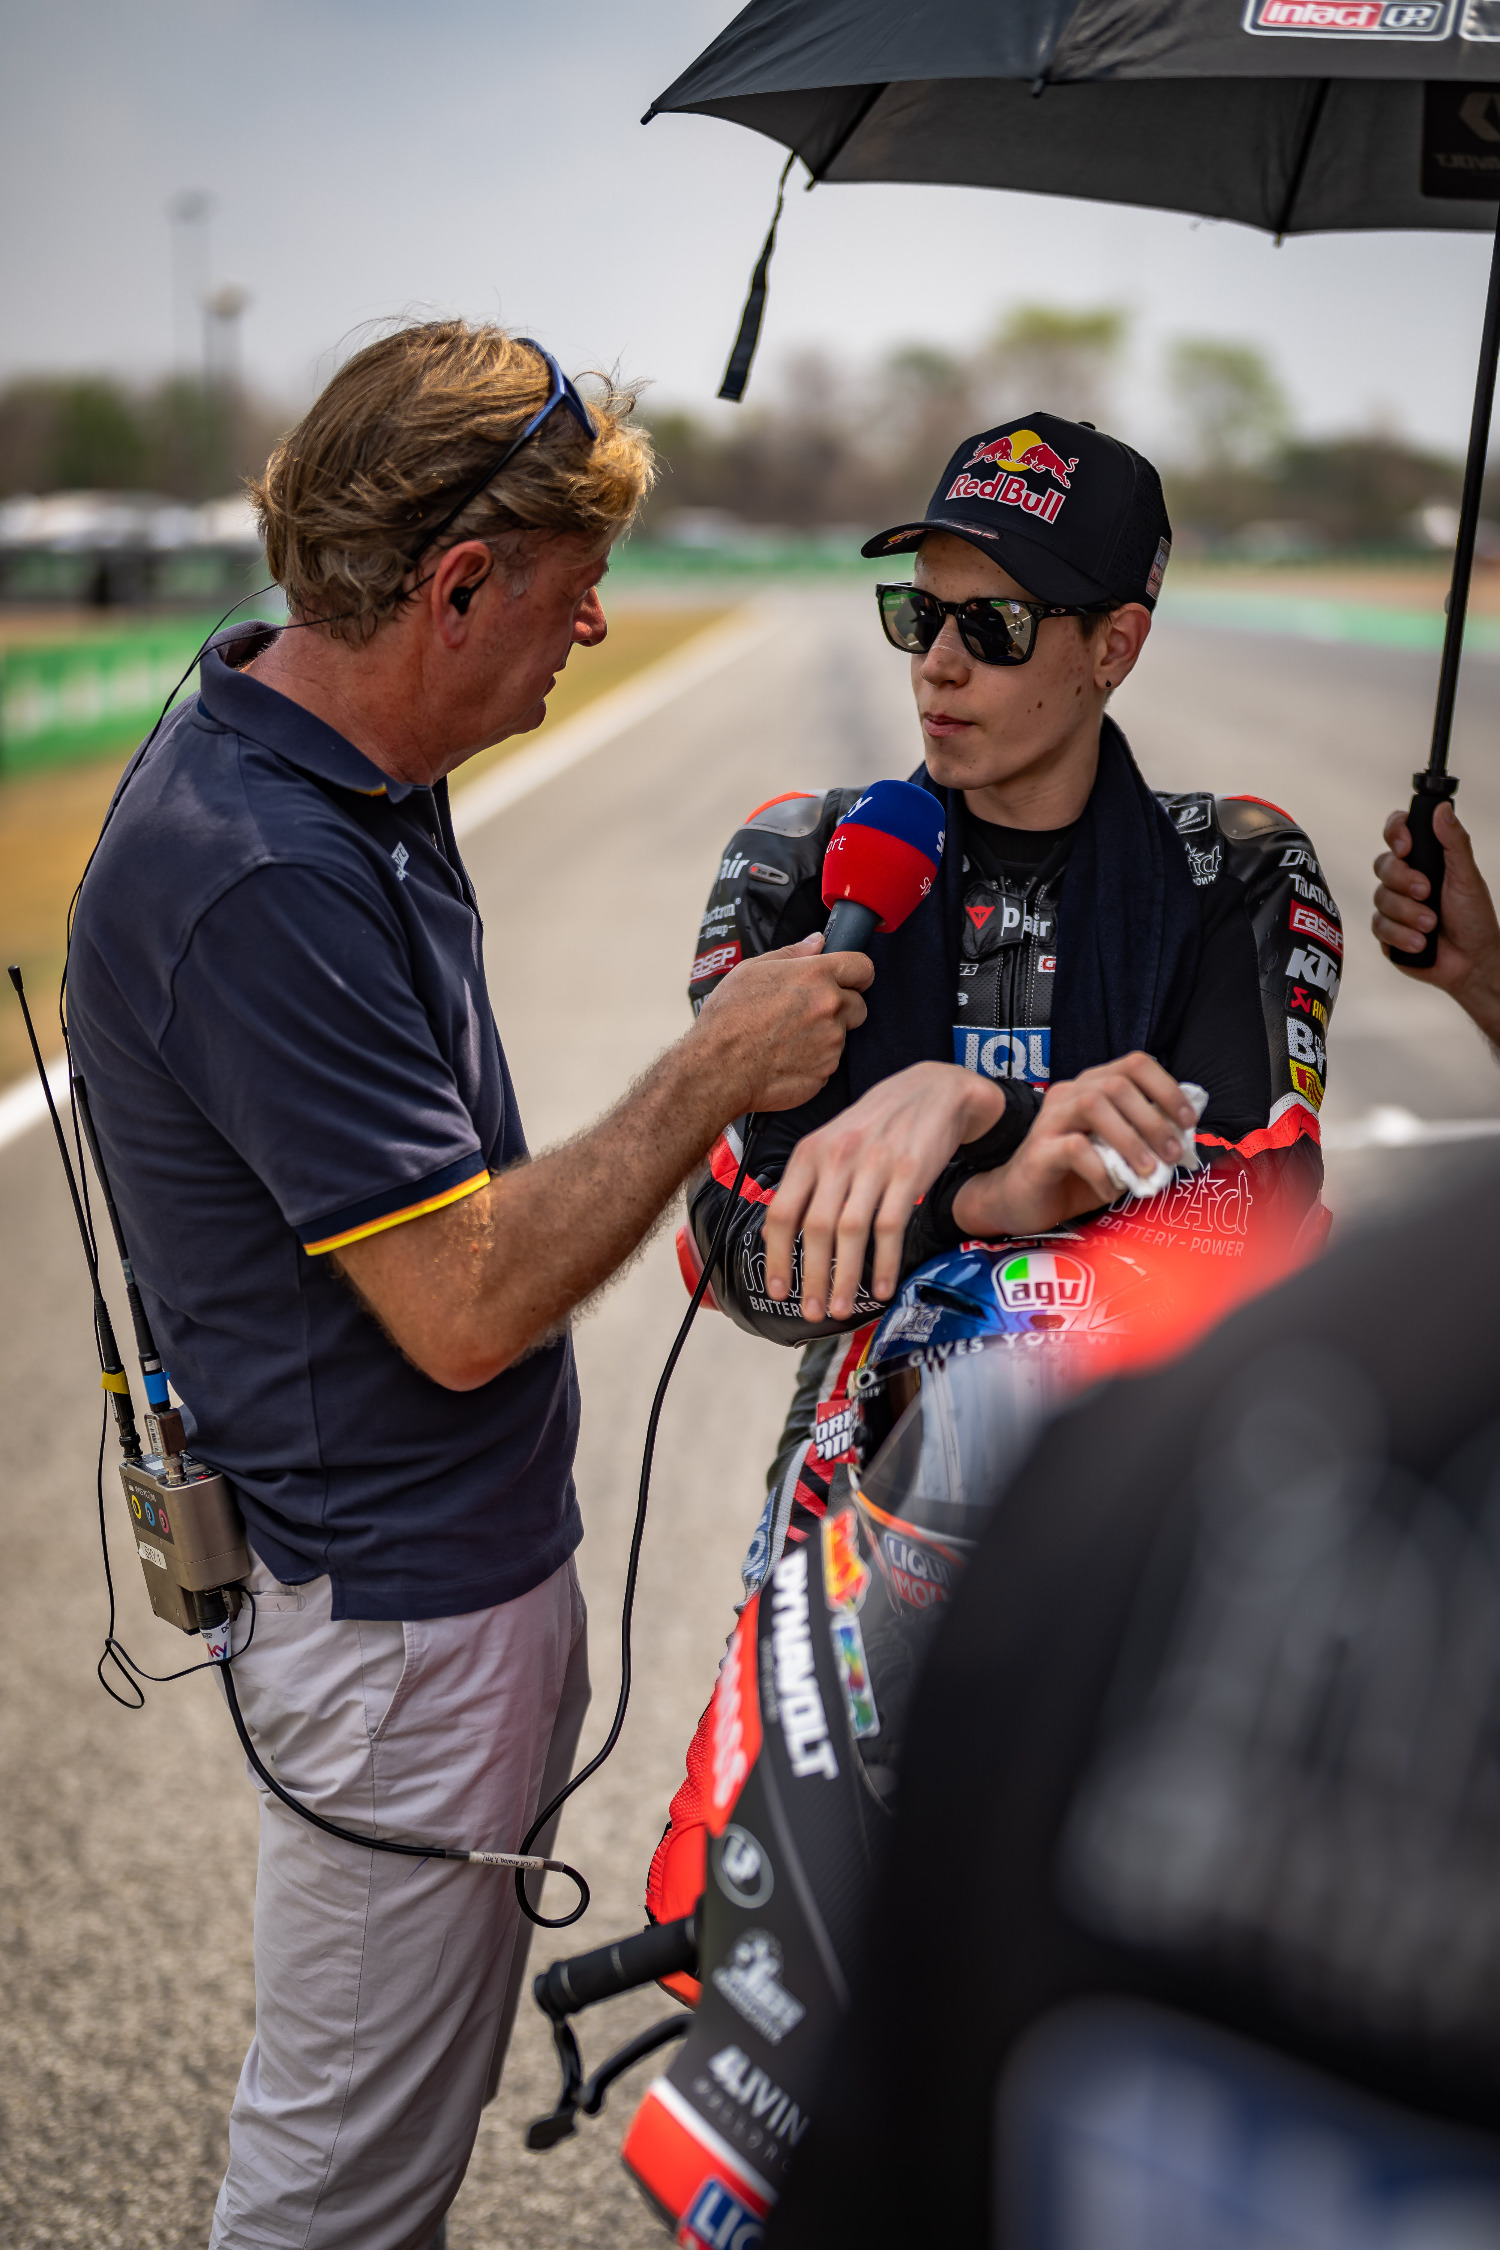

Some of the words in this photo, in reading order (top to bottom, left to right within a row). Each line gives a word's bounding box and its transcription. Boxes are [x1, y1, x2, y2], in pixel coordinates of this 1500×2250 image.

[945, 472, 1007, 500] Red
[997, 476, 1066, 524] Bull
[1097, 1215, 1178, 1249] BATTERY
[1189, 1237, 1245, 1257] POWER
[1012, 1281, 1079, 1305] agv
[908, 1337, 985, 1367] GIVES
[1002, 1331, 1066, 1347] YOU
